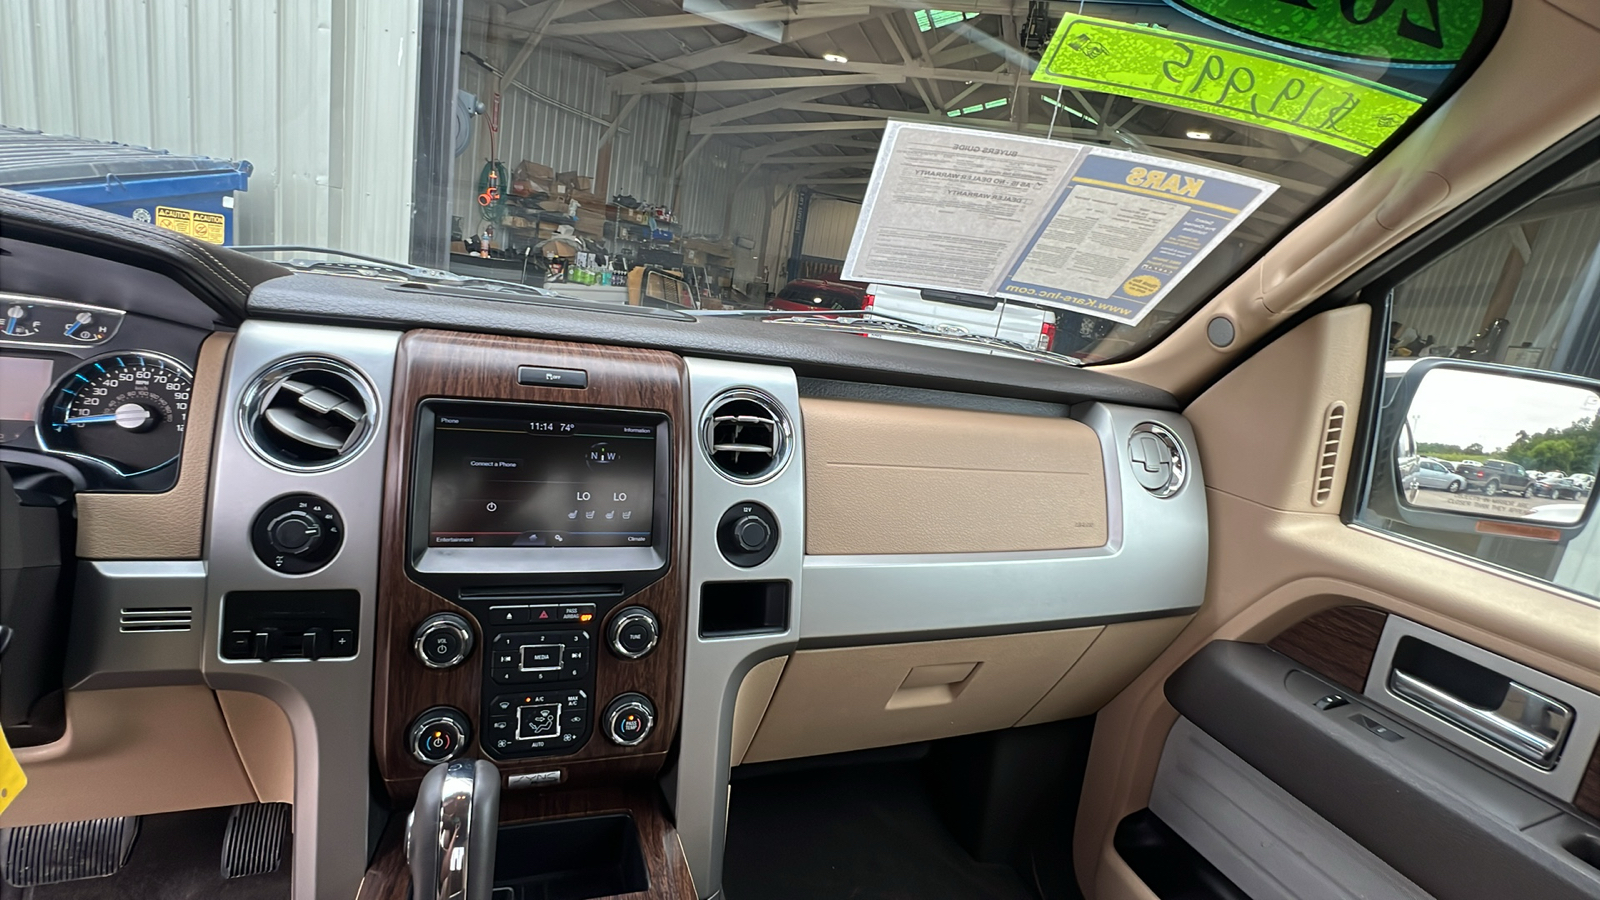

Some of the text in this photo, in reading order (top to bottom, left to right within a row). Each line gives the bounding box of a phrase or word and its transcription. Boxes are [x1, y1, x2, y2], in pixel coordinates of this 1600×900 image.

[166, 210, 190, 219] CAUTION
[200, 215, 223, 223] CAUTION
[119, 373, 134, 381] 50
[136, 371, 151, 379] 60
[103, 379, 118, 387] 40
[154, 375, 168, 384] 70
[166, 382, 181, 391] 80
[92, 388, 108, 396] 30
[174, 392, 189, 400] 90
[83, 397, 100, 406] 20
[78, 408, 91, 416] 10
[529, 422, 554, 431] 11:14
[591, 452, 598, 460] N
[607, 452, 616, 460] W
[470, 460, 493, 468] Connect
[577, 492, 591, 501] LO
[613, 492, 627, 501] LO
